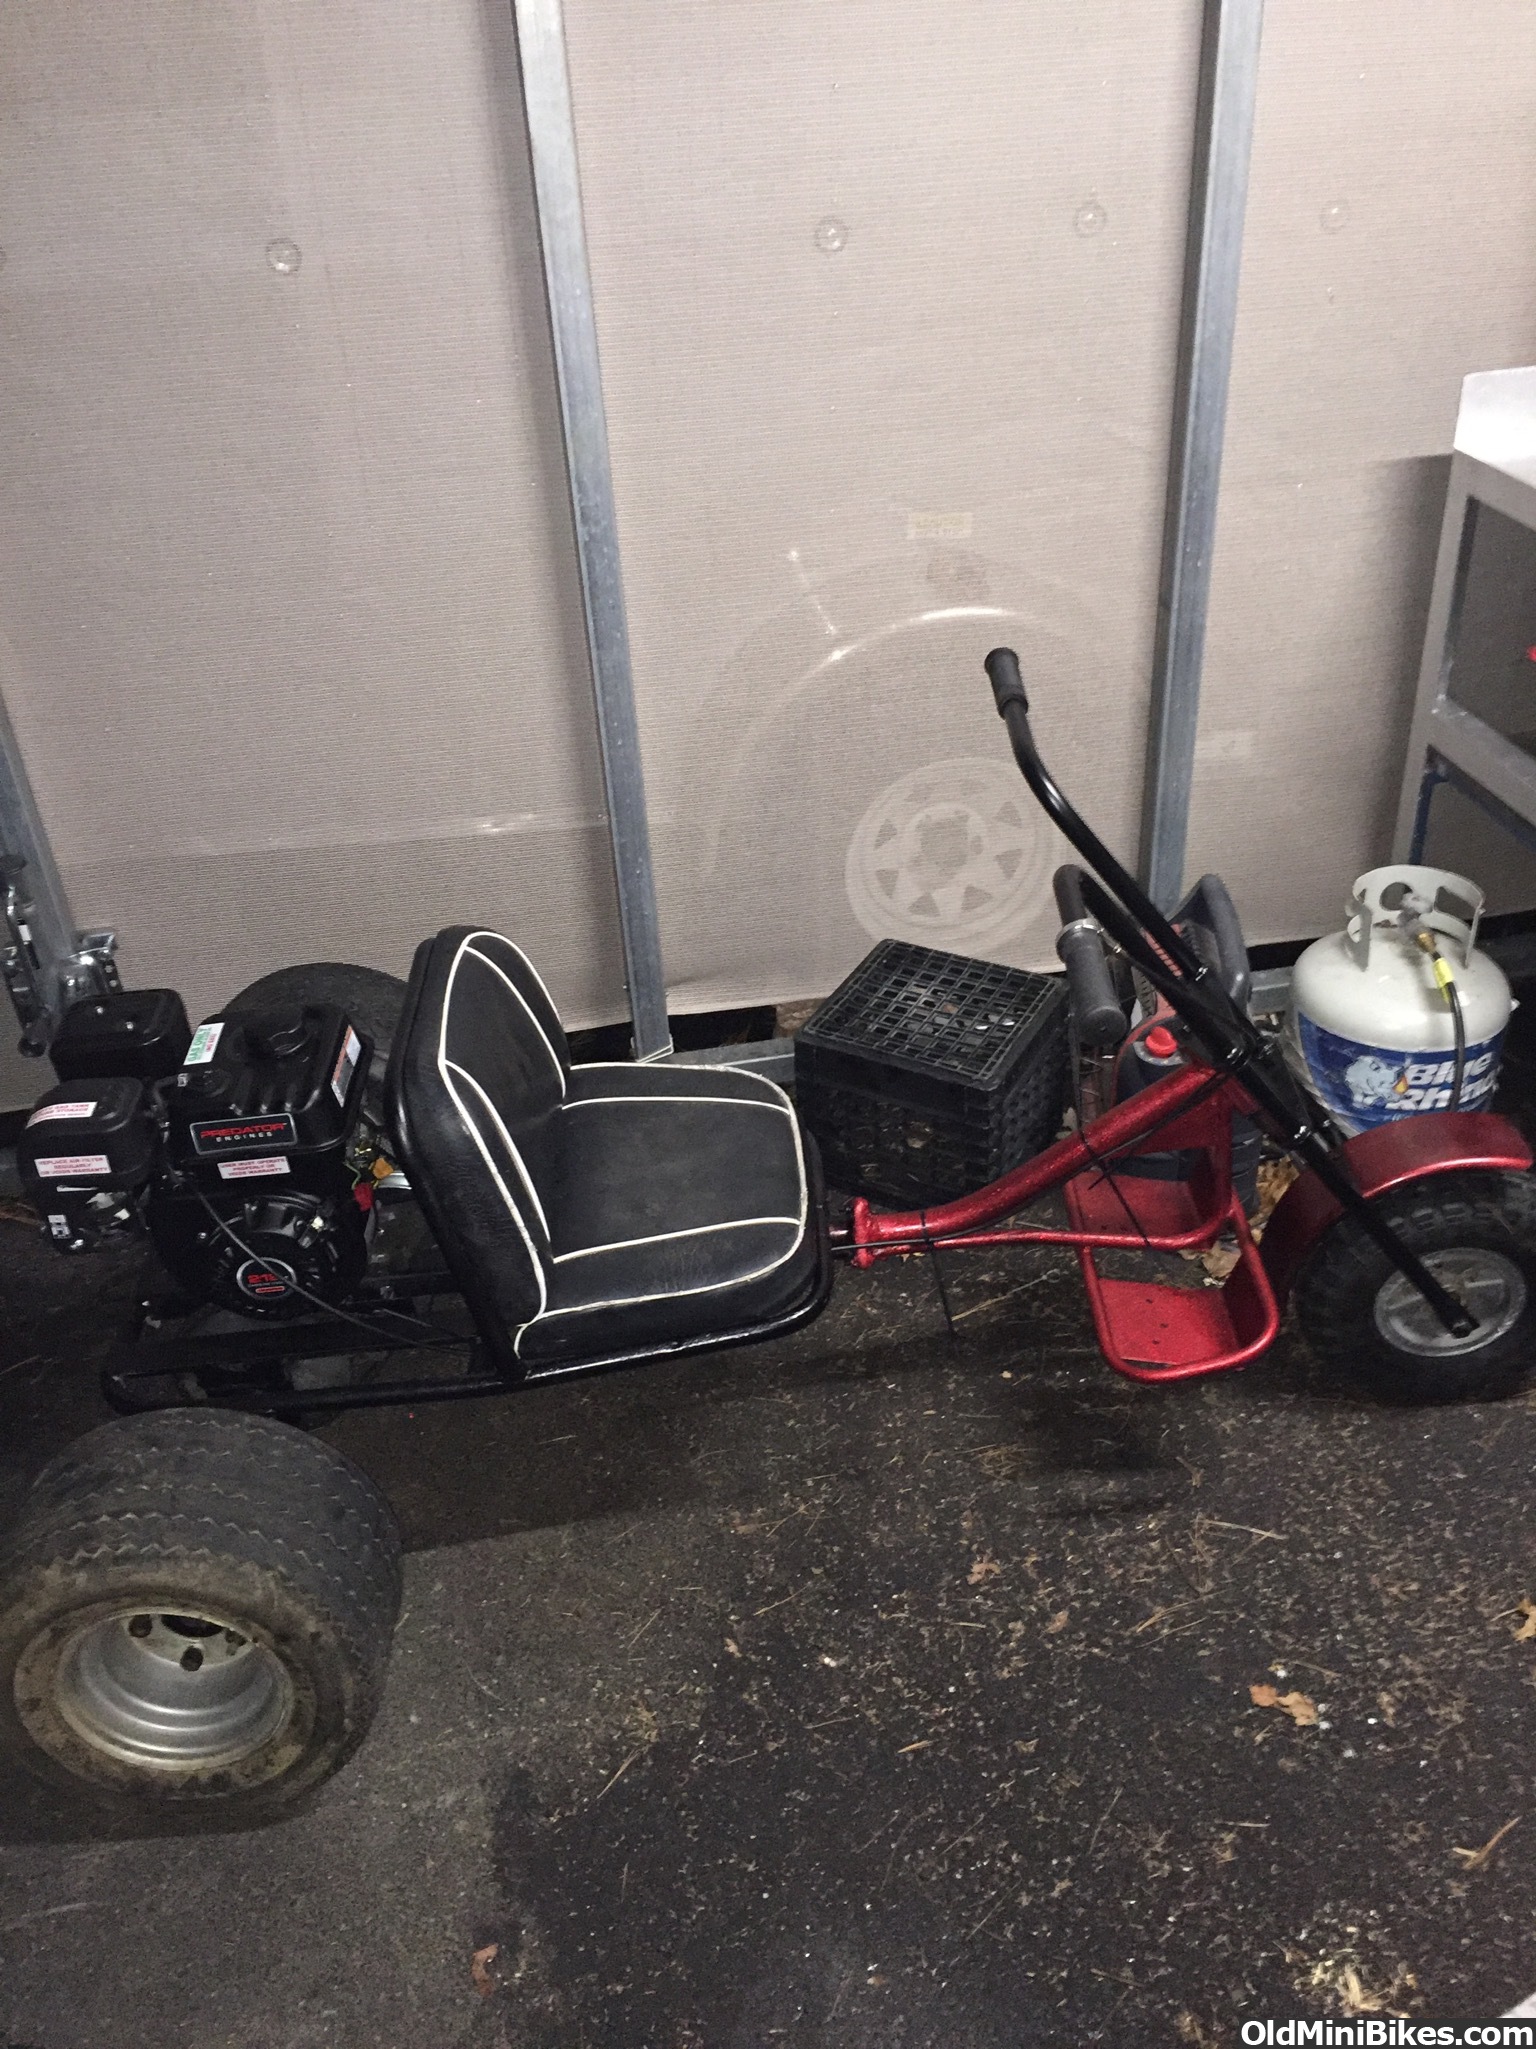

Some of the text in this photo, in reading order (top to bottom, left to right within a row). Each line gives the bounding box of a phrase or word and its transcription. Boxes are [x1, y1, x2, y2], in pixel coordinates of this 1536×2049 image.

[1385, 1070, 1499, 1111] Rhno
[200, 1123, 285, 1138] PREDATOR
[215, 1131, 273, 1143] ENGINES
